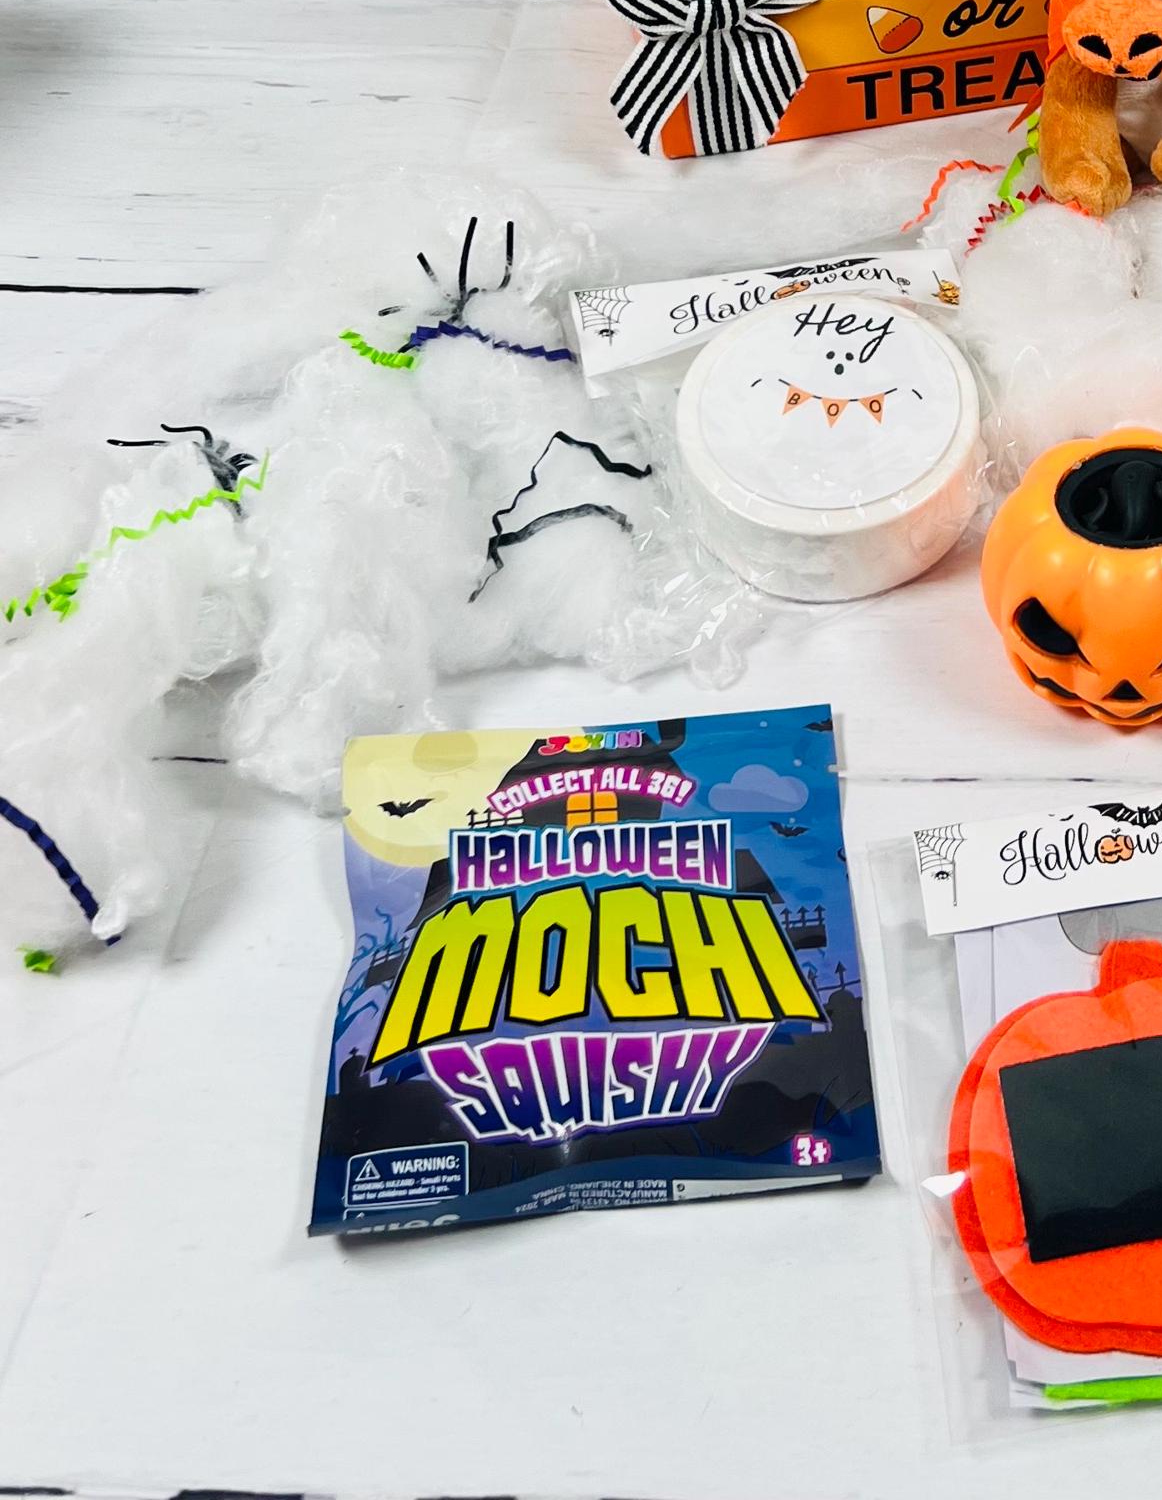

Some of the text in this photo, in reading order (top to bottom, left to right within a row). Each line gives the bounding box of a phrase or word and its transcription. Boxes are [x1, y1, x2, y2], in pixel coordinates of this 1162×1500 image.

[846, 50, 1046, 120] TREA
[669, 266, 911, 335] Halloween
[794, 303, 895, 364] Hey
[538, 730, 643, 756] JOYIN
[491, 766, 693, 813] COLLECT ALL 36!
[366, 884, 828, 1070] MOCHI
[421, 1023, 775, 1142] SQUISHY
[391, 1155, 460, 1175] WARNING:
[793, 1135, 831, 1167] 3+
[441, 1174, 461, 1183] Parts
[580, 1189, 668, 1199] MANUFACTURED
[623, 1179, 635, 1189] IN
[637, 1179, 667, 1189] MADE
